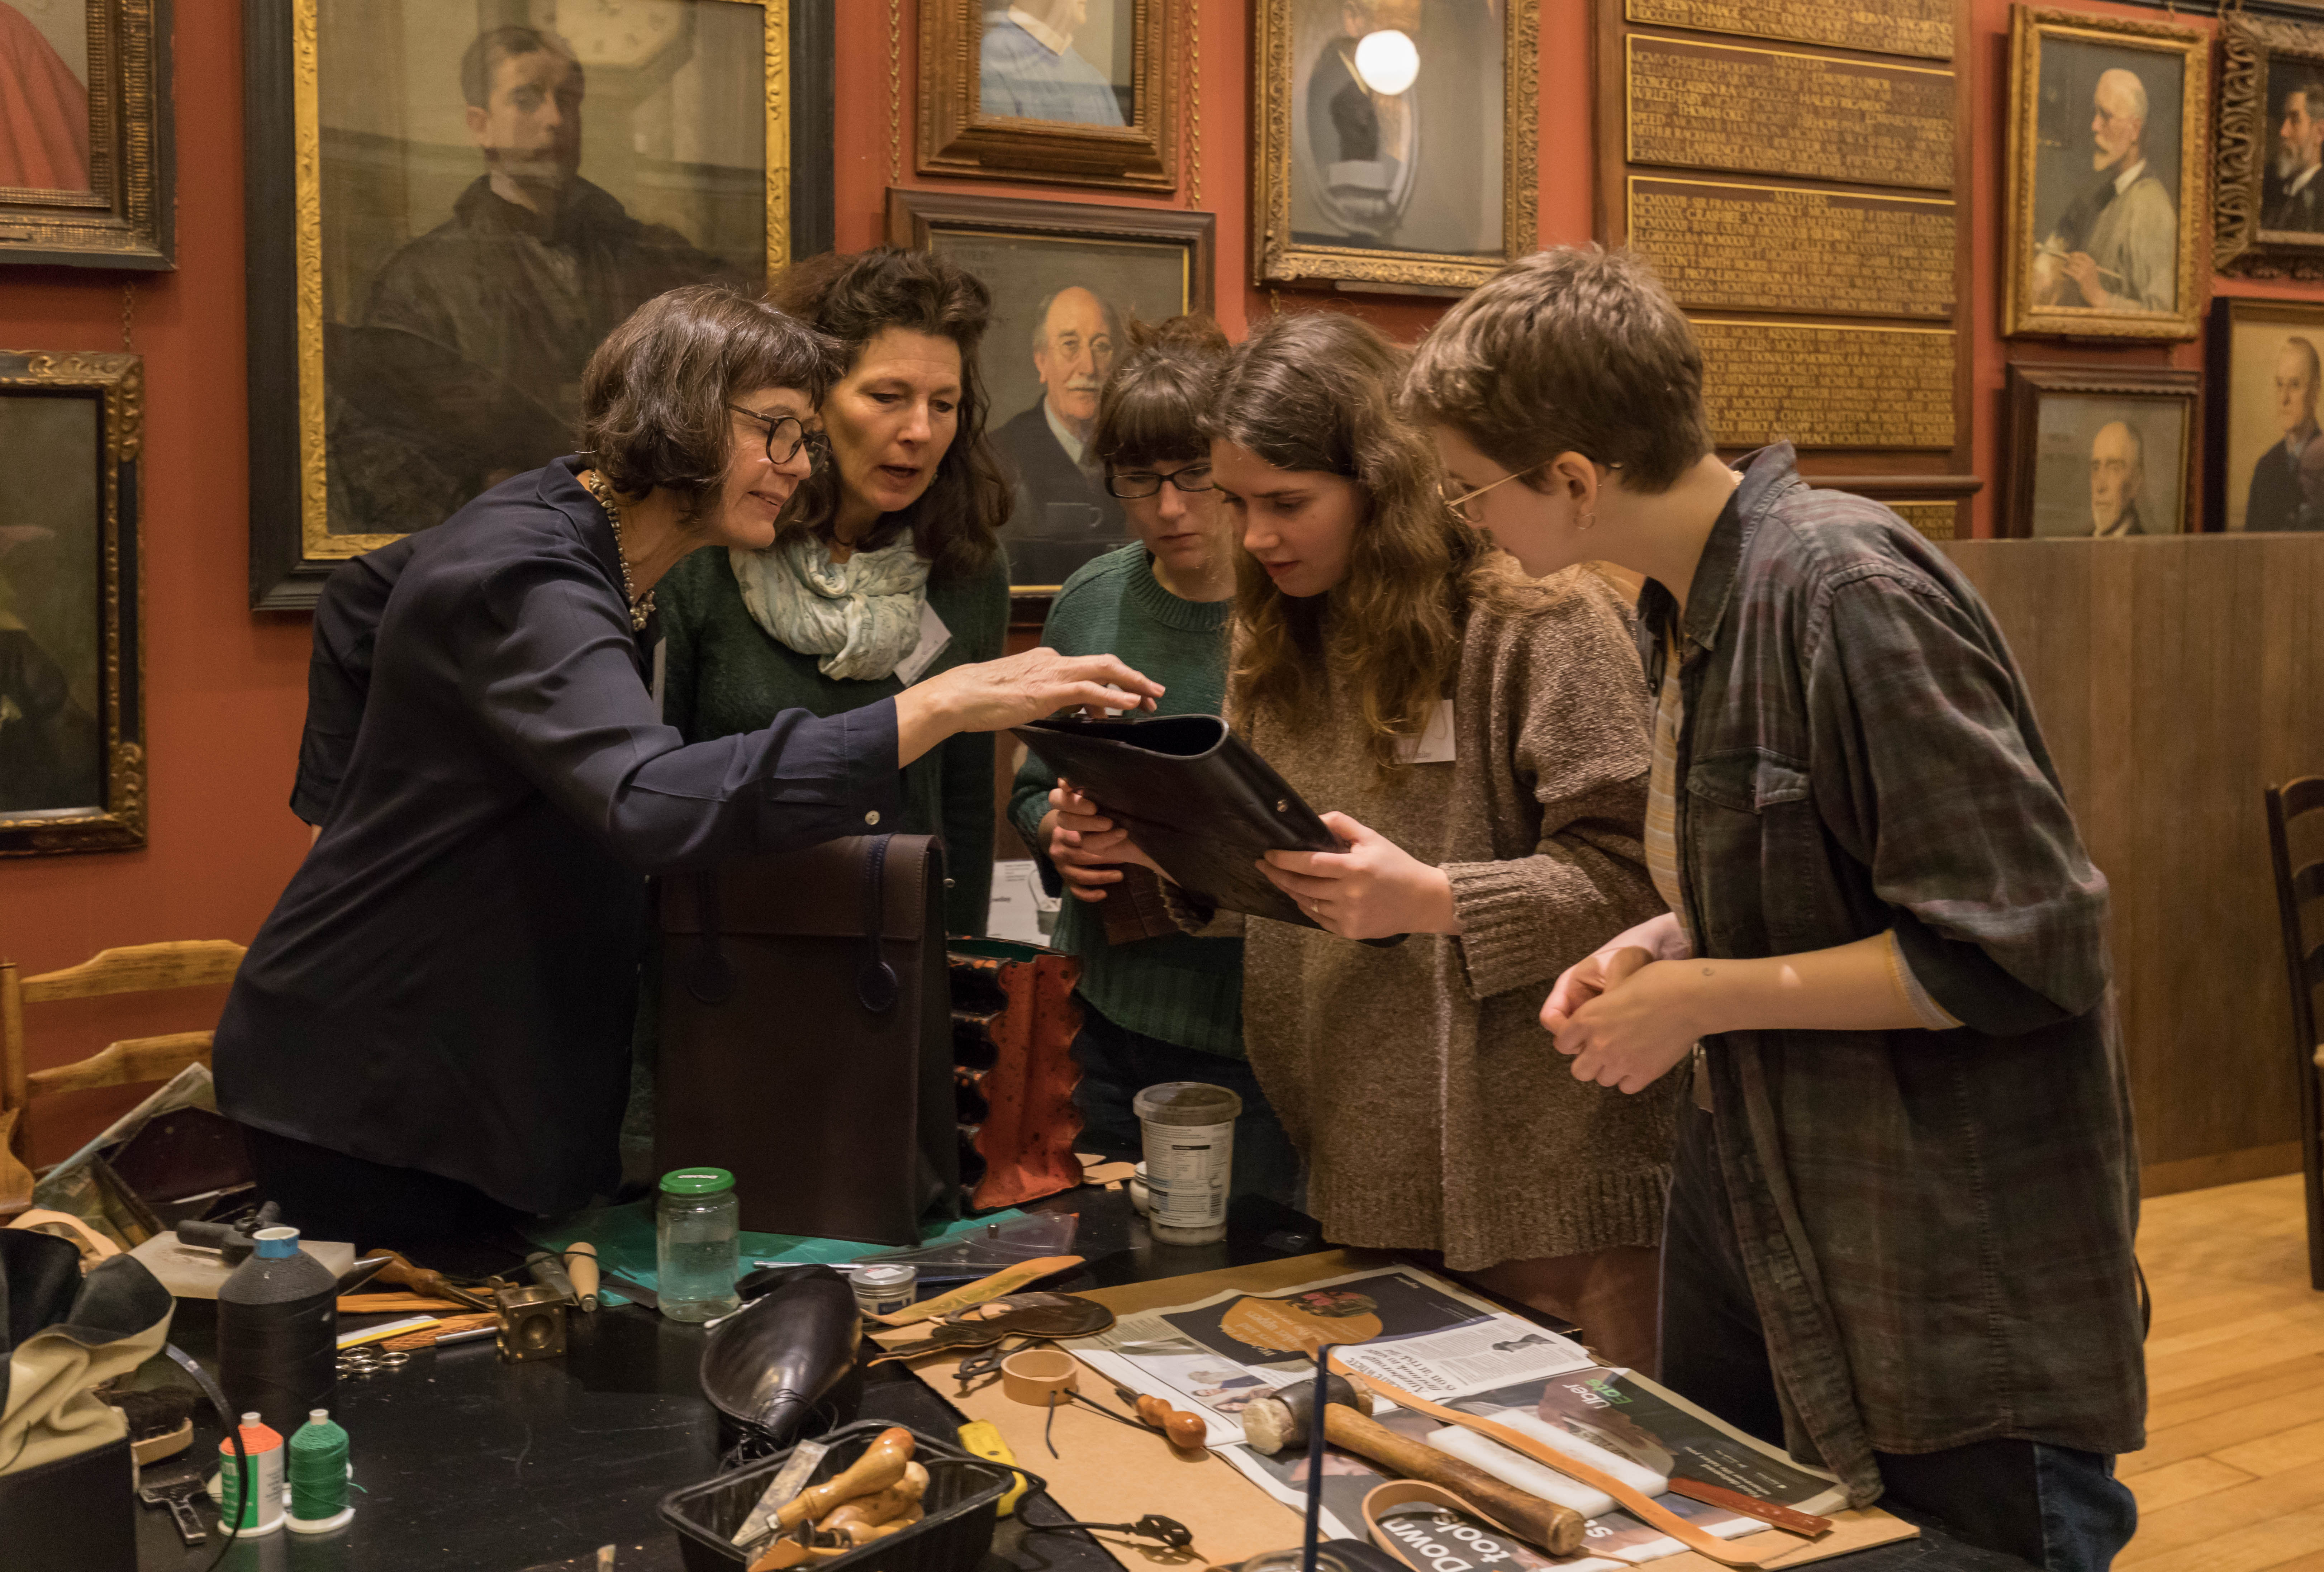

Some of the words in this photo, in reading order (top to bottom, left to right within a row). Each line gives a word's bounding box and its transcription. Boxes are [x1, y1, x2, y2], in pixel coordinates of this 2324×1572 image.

[1360, 1355, 1429, 1392] Attenborough
[1396, 1364, 1422, 1379] took
[1430, 1374, 1447, 1385] on
[1419, 1379, 1443, 1391] first
[1562, 1384, 1611, 1409] Uber
[1584, 1379, 1632, 1404] Eats
[1382, 1518, 1474, 1572] Down
